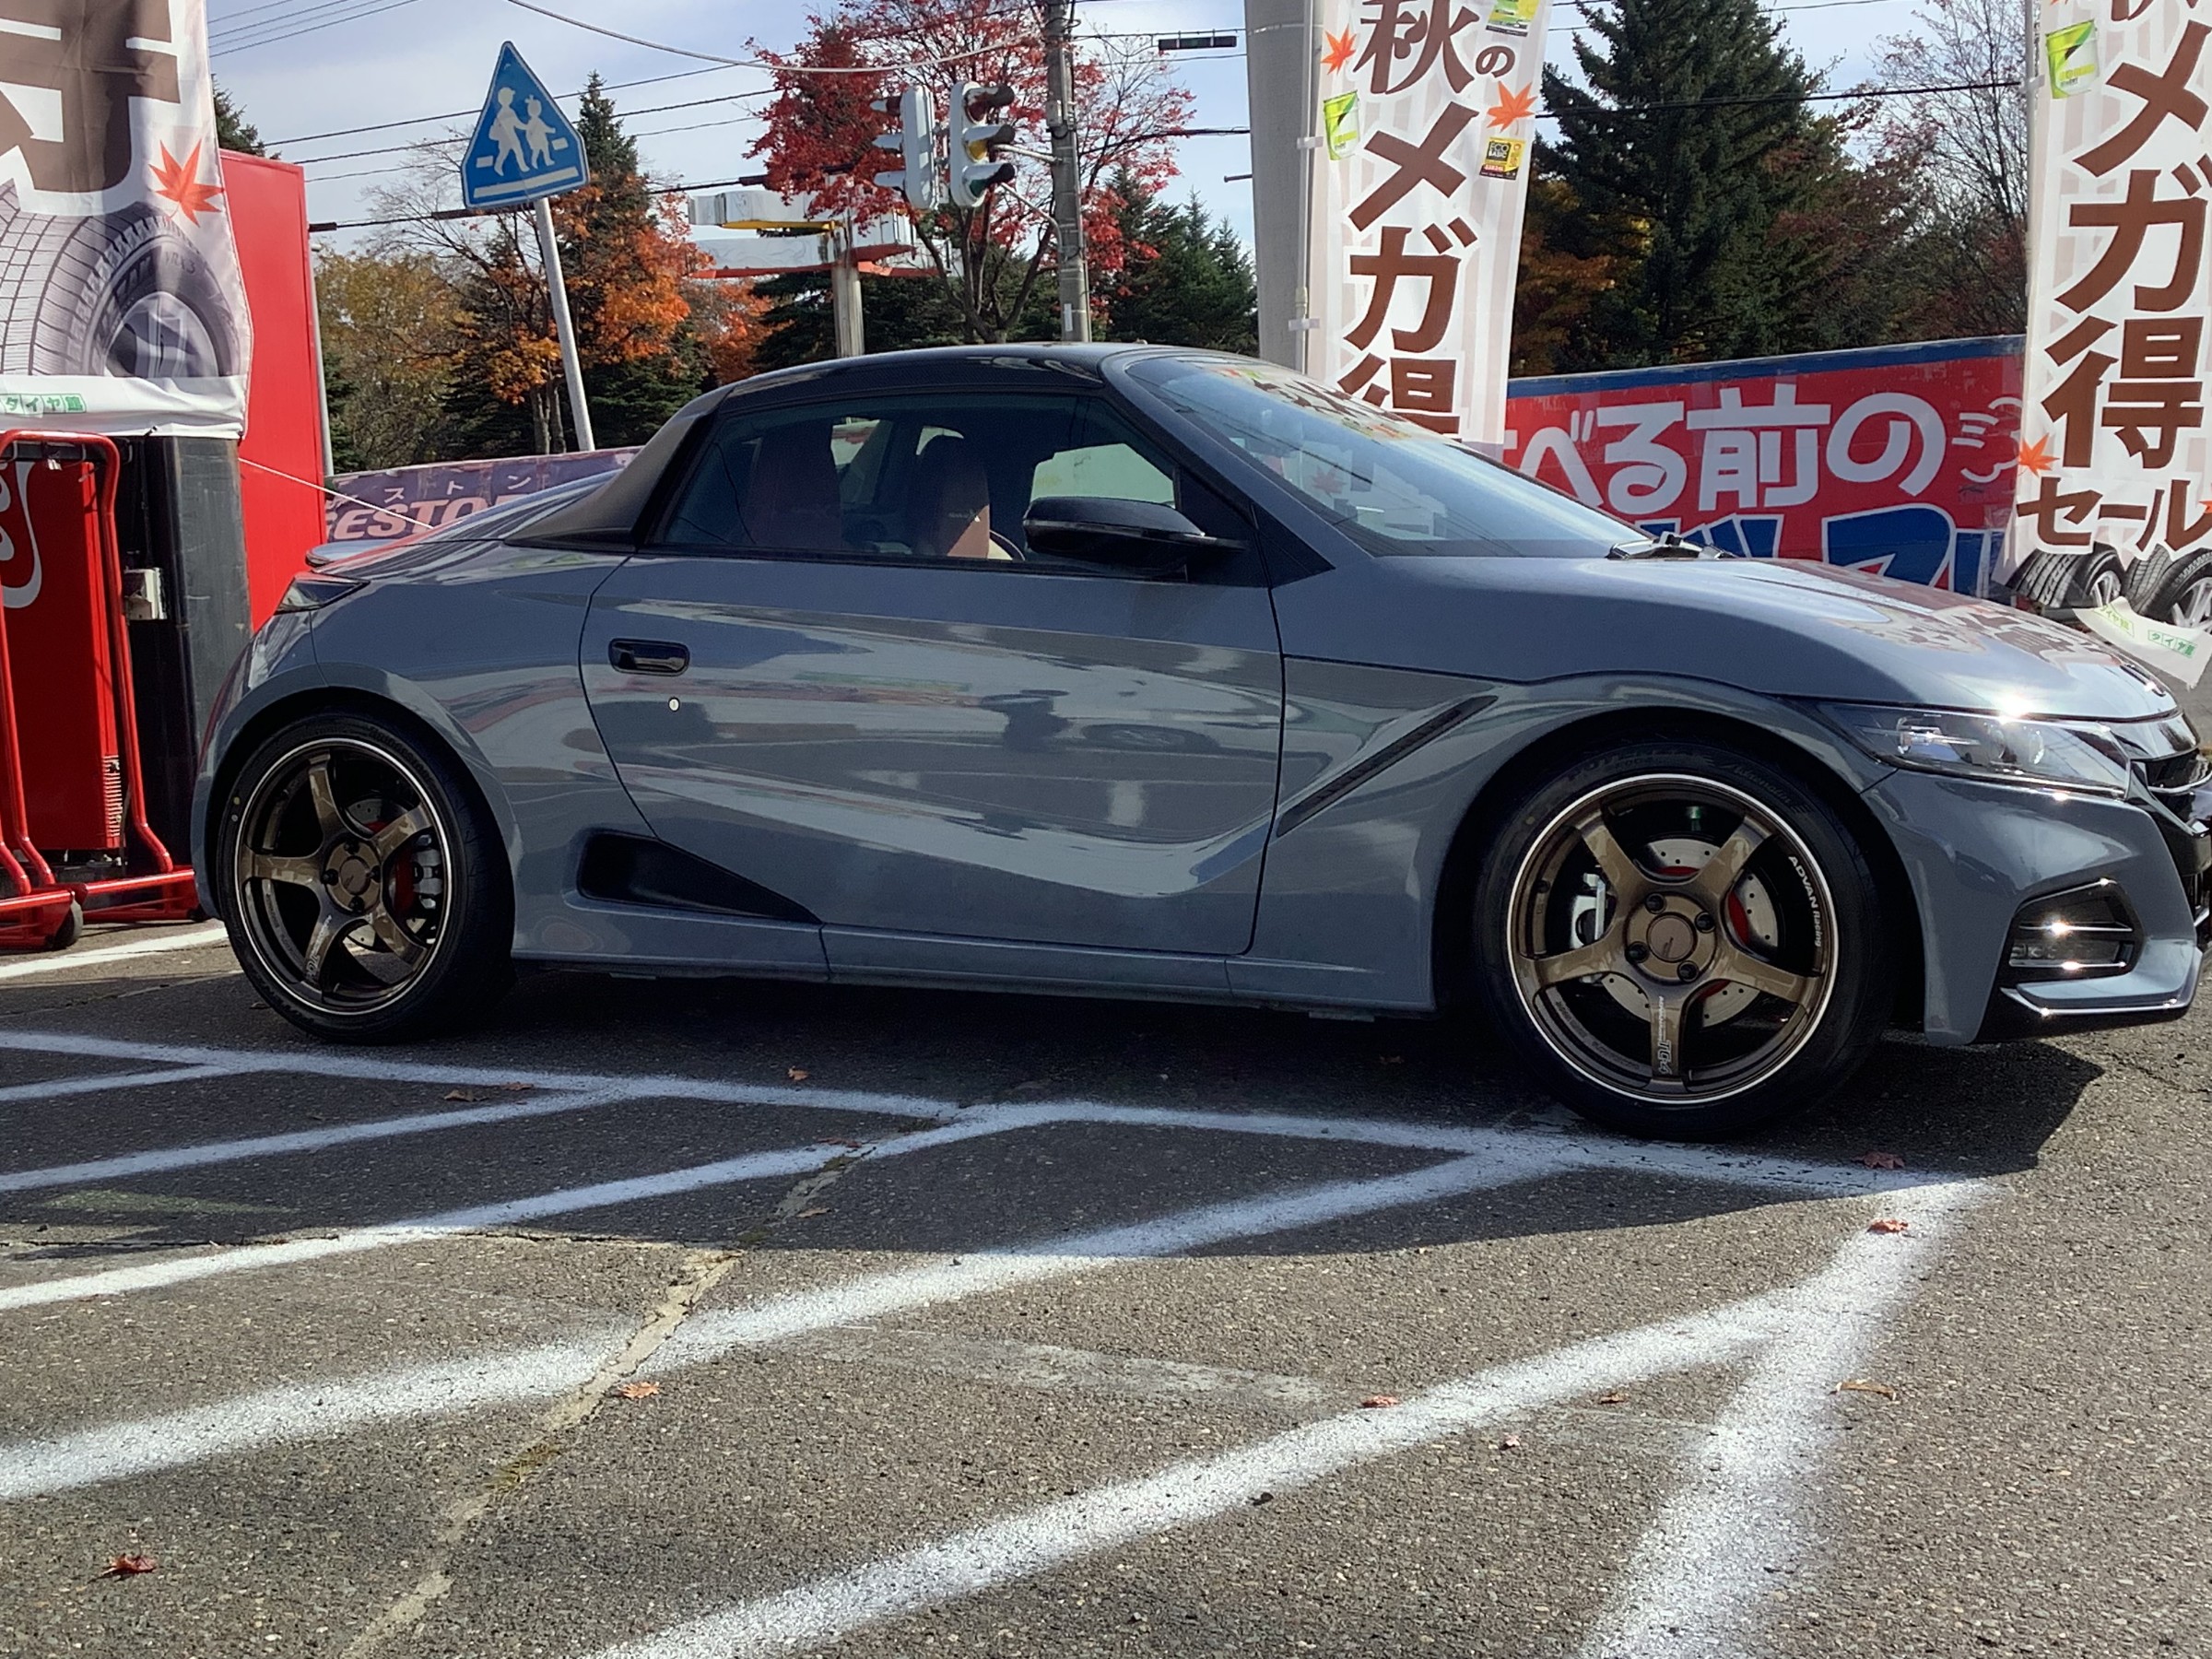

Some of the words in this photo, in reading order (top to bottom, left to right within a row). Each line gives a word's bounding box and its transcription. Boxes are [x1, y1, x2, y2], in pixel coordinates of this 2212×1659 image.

[2041, 19, 2212, 469] メガ得
[1503, 383, 1946, 514] べる前の
[2017, 476, 2212, 552] セール
[1788, 856, 1818, 909] ADVAN
